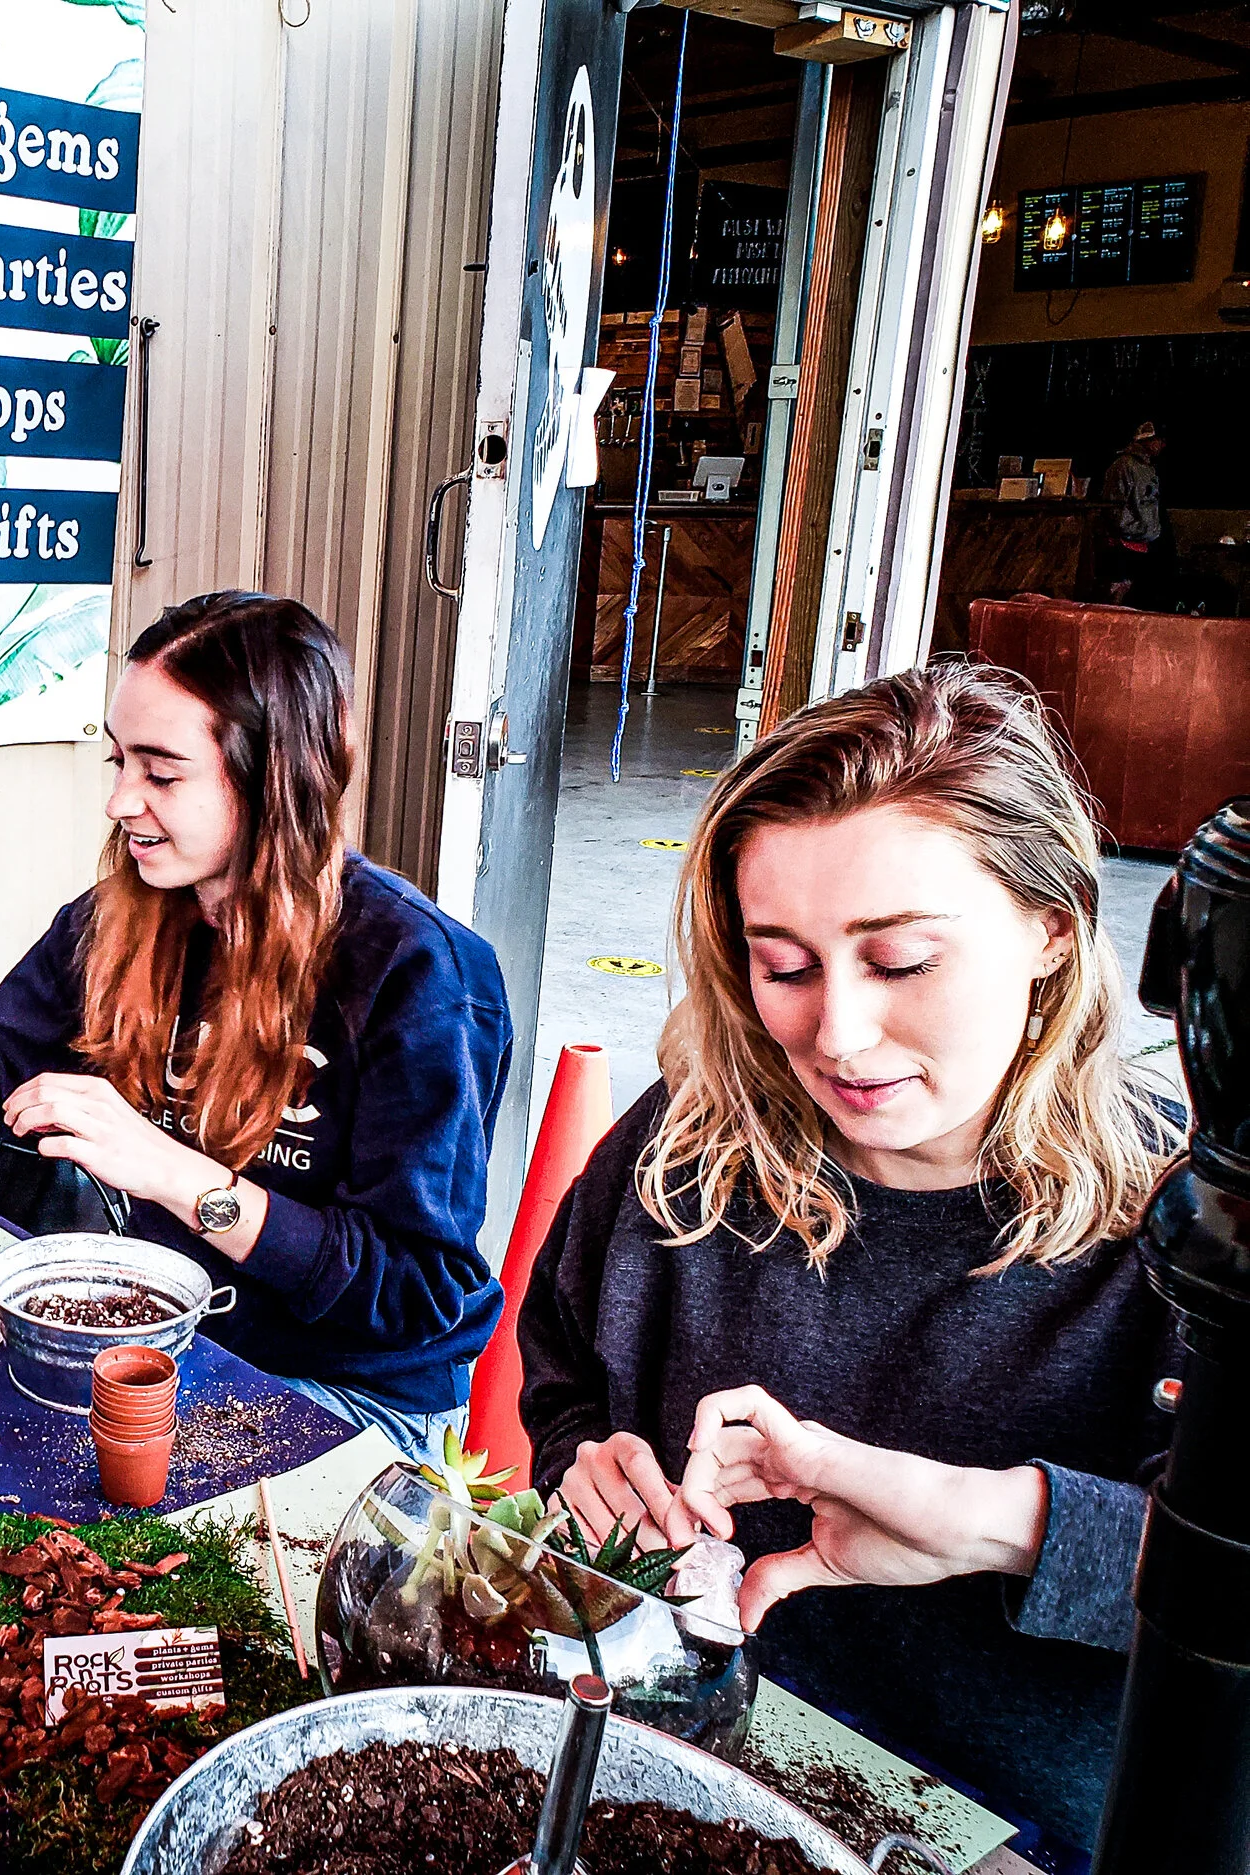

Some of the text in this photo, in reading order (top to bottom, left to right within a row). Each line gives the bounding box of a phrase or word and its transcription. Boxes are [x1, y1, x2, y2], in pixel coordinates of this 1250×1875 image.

[152, 1648, 182, 1657] plants
[151, 1656, 217, 1670] private parties
[160, 1671, 211, 1682] workshops
[156, 1685, 213, 1696] custom gifts
